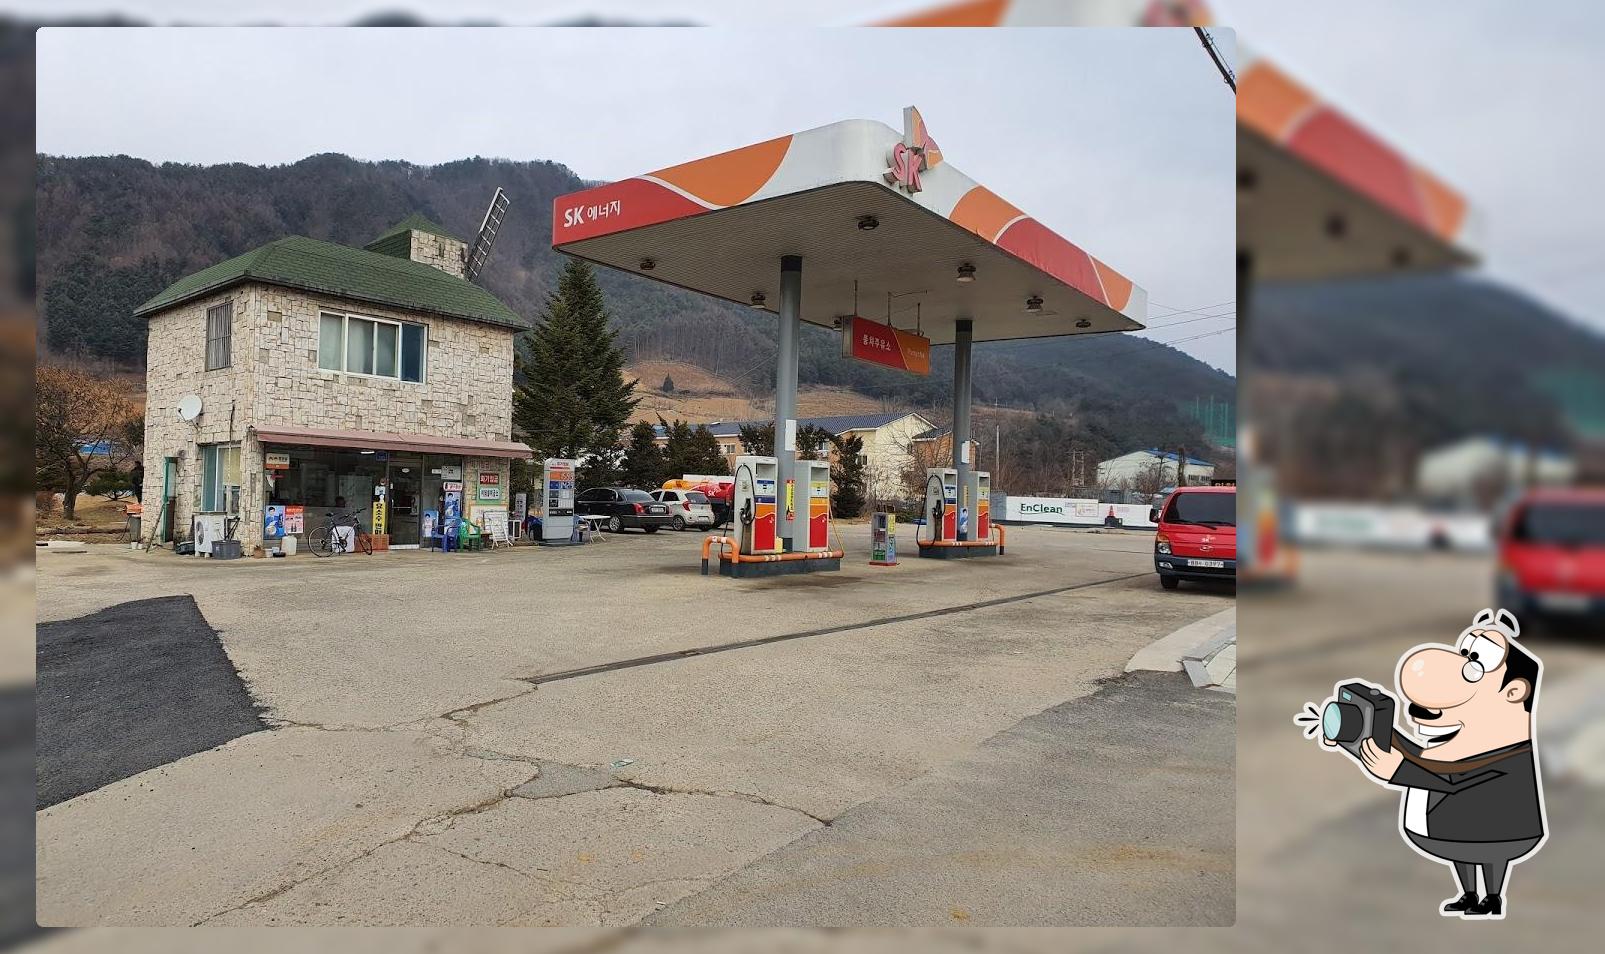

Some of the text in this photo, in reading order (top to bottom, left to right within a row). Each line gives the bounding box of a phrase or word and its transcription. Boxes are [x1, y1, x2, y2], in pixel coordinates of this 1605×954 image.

[887, 140, 924, 194] SK
[563, 200, 621, 228] SK 에너지
[375, 503, 383, 521] 요소수
[1020, 503, 1063, 515] EnClean
